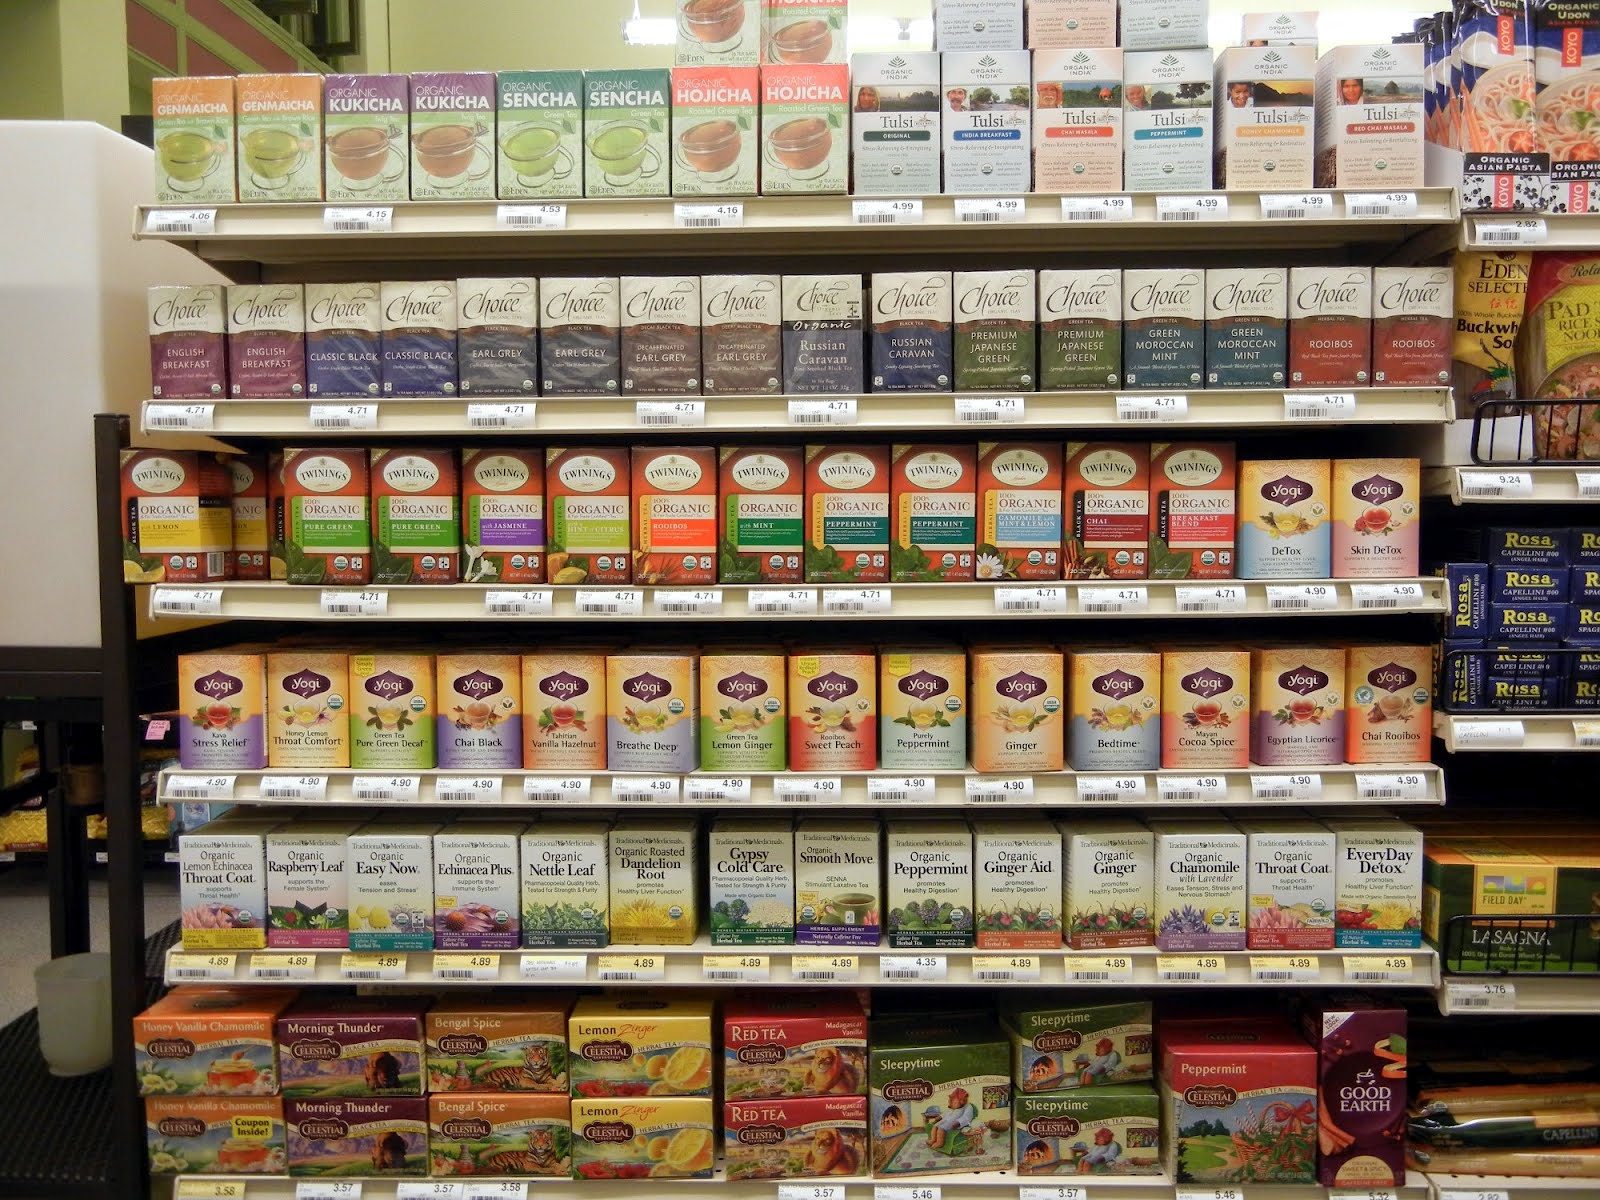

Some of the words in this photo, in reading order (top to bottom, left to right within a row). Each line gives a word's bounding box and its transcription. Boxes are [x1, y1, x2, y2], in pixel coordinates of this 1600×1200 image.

[1566, 32, 1578, 64] KOYO
[415, 86, 464, 96] ORGANIC
[502, 82, 551, 91] ORGANIC
[767, 87, 842, 100] HOJICHA
[329, 98, 403, 112] KUKICHA
[415, 97, 489, 109] KUKICHA
[503, 93, 578, 107] SENCHA
[158, 103, 228, 115] GENMAICHA
[880, 114, 914, 128] Tulsi
[971, 115, 1004, 127] Tulsi
[1152, 112, 1186, 126] Tulsi
[1468, 164, 1503, 172] ASIAN
[1506, 163, 1541, 171] PASTA
[1213, 273, 1282, 311] Choice
[971, 332, 1017, 340] PREMIUM
[1149, 329, 1181, 338] GREEN
[800, 340, 846, 350] Russian
[971, 343, 1017, 352] JAPANESE
[1136, 340, 1194, 350] MOROCCAN
[1309, 340, 1353, 349] ROOIBOS
[168, 349, 205, 357] ENGLISH
[310, 353, 344, 361] CLASSIC
[349, 353, 377, 361] BLACK
[636, 354, 659, 362] EARL
[662, 354, 686, 362] GREY
[798, 353, 847, 364] Caravan
[978, 354, 1011, 363] GREEN
[1152, 352, 1178, 361] MINT
[162, 360, 211, 369] BREAKFAST
[1155, 398, 1176, 406] 4.71
[135, 469, 183, 482] TWININGS
[563, 467, 613, 481] TWININGS
[1172, 499, 1230, 509] ORGANIC
[140, 505, 195, 515] ORGANIC
[1505, 532, 1551, 548] Rosa
[1272, 546, 1301, 556] DeTox
[1351, 546, 1370, 555] Skin
[1373, 546, 1402, 555] DeTox
[615, 592, 635, 600] 4.71
[1393, 586, 1414, 595] 4.90
[285, 730, 304, 738] Honey
[1362, 732, 1382, 740] Chai
[1385, 732, 1420, 740] Rooibos
[192, 738, 217, 747] Stress
[221, 738, 248, 747] Relief
[273, 737, 300, 745] Throat
[303, 736, 342, 745] Comfort
[356, 739, 375, 747] Pure
[378, 739, 399, 747] Green
[402, 739, 425, 747] Decaf
[532, 740, 559, 748] Vanilla
[562, 740, 597, 748] Hazelnut
[712, 740, 741, 749] Lemon
[744, 740, 773, 751] Ginger
[897, 739, 950, 750] Peppermint
[1179, 737, 1206, 746] Cocoa
[1210, 737, 1235, 748] Spice
[1267, 736, 1302, 746] Egyptian
[1305, 735, 1336, 744] Licorice
[616, 740, 651, 750] Breathe
[654, 742, 677, 753] Deep
[1005, 741, 1037, 752] Ginger
[206, 778, 227, 786] 4.90
[651, 781, 671, 789] 4.90
[800, 853, 841, 864] Smooth
[844, 854, 873, 864] Move
[1347, 848, 1413, 864] EveryDay
[183, 862, 211, 871] Lemon
[213, 862, 253, 871] Echinacea
[269, 861, 318, 875] Raspberry
[321, 861, 344, 871] Leaf
[621, 858, 681, 869] Dandelion
[717, 861, 750, 873] Cold
[753, 861, 783, 873] Care
[984, 861, 1028, 877] Ginger
[1030, 861, 1051, 873] Aid
[1170, 861, 1240, 873] Chamomile
[1360, 861, 1402, 874] Detox
[356, 862, 384, 877] Easy
[388, 863, 418, 874] Now
[438, 864, 488, 875] Echinacea
[491, 864, 511, 875] Plus
[530, 864, 565, 876] Nettle
[568, 864, 595, 876] Leaf
[637, 869, 665, 880] Root
[894, 863, 968, 878] Peppermint
[183, 872, 222, 883] Throat
[226, 873, 254, 883] Coat
[992, 886, 1014, 894] Healthy
[1483, 896, 1505, 904] FIELD
[1508, 897, 1523, 905] DAY
[208, 957, 228, 966] 4.89
[634, 959, 654, 968] 4.89
[288, 1024, 334, 1035] Morning
[339, 1023, 382, 1033] Thunder
[435, 1018, 470, 1029] Bengal
[473, 1018, 500, 1029] Spice
[579, 1025, 616, 1035] Lemon
[620, 1023, 657, 1039] Zinger
[732, 1026, 759, 1041] RED
[761, 1028, 786, 1040] TEA
[881, 1059, 940, 1071] Sleepytime
[1181, 1064, 1247, 1075] Peppermint
[1340, 1087, 1391, 1099] GOOD
[1340, 1100, 1391, 1112] EARTH
[235, 1118, 269, 1127] Coupon
[237, 1127, 268, 1136] Inside!
[912, 1190, 932, 1199] 5.46
